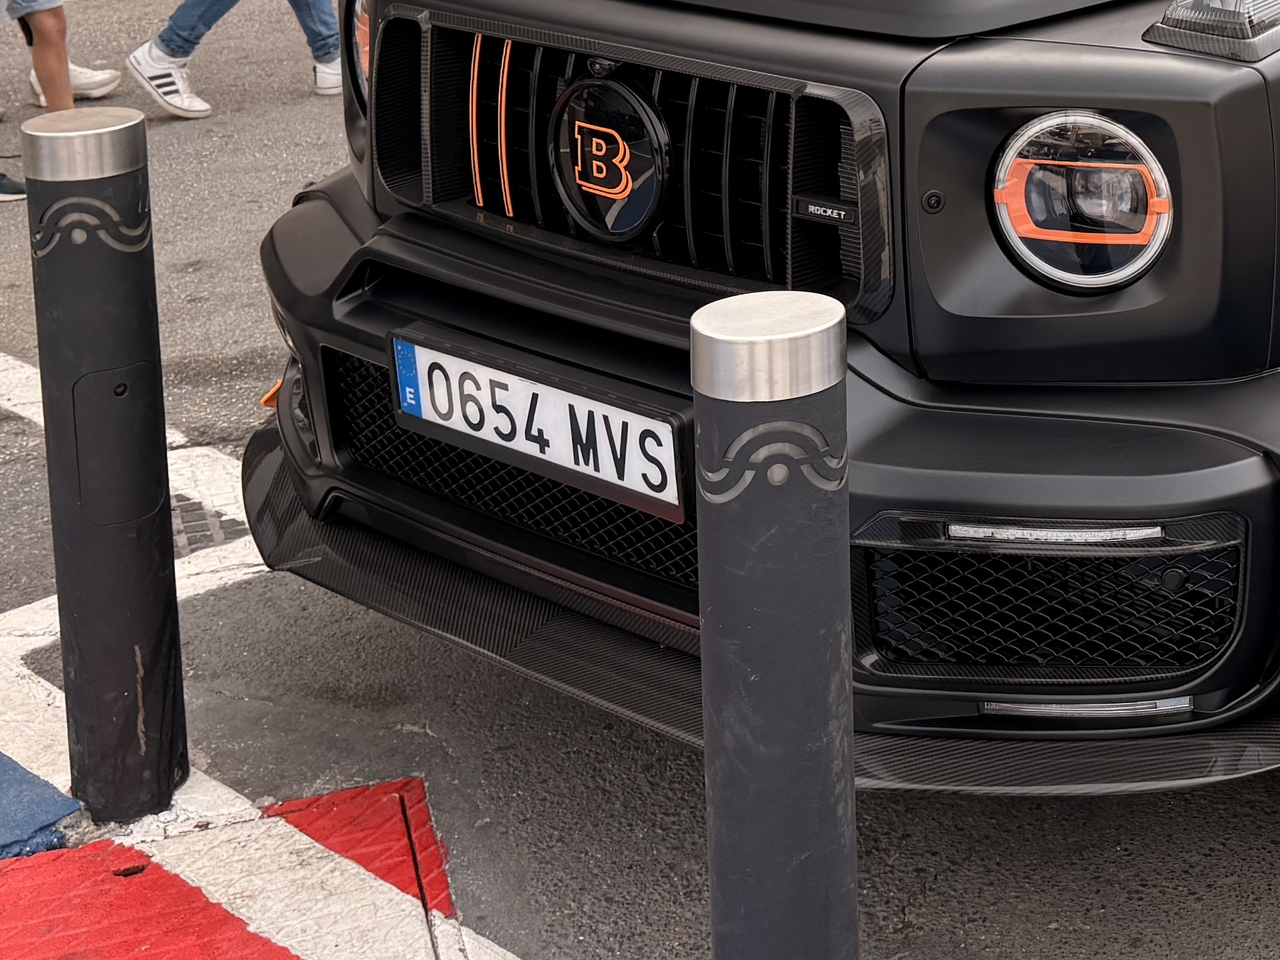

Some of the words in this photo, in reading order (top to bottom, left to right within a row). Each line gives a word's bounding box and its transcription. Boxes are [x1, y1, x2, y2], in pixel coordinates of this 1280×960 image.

[574, 120, 634, 201] B
[807, 204, 847, 220] ROCKET
[405, 386, 416, 406] E
[427, 361, 551, 456] 0654
[568, 402, 668, 494] MVS
